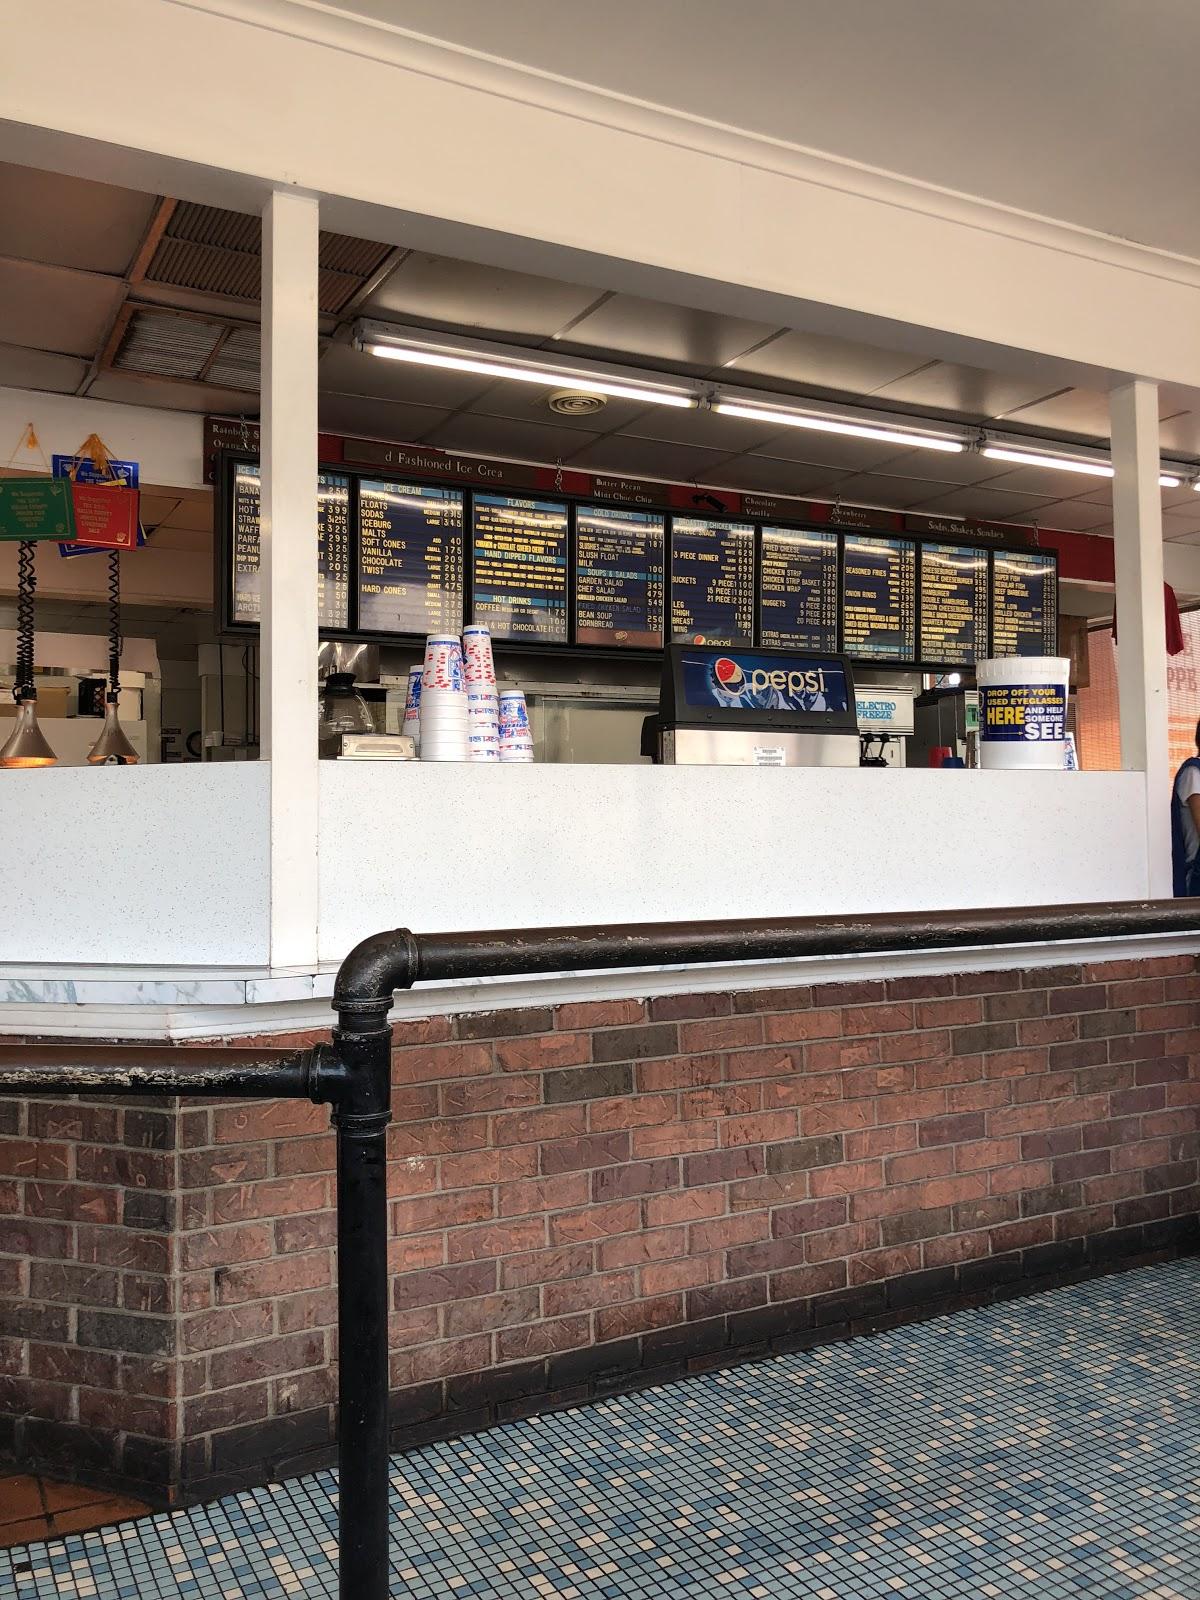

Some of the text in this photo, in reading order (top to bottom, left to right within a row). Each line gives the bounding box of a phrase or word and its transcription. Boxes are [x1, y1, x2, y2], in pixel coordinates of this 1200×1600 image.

[398, 453, 450, 471] Fashioned
[457, 461, 472, 474] Ice
[384, 483, 394, 492] ICE
[397, 485, 422, 495] CREAM
[596, 478, 641, 491] Butter Pecan
[593, 490, 611, 499] Mint
[635, 495, 652, 504] Chip
[360, 499, 388, 510] FLOATS
[507, 499, 536, 509] FLAVORS
[745, 497, 777, 508] Chocolate
[238, 505, 347, 515] HOT 399
[360, 509, 384, 519] SODAS
[746, 508, 770, 518] Vanilla
[327, 524, 347, 533] 325
[361, 519, 392, 530] ICEBURG
[709, 522, 733, 530] CHICKEN
[361, 528, 386, 538] MALTS
[328, 534, 347, 543] 299
[328, 543, 347, 553] 325
[361, 538, 381, 547] SOFT
[383, 540, 406, 550] CONES
[649, 540, 663, 548] 187
[762, 543, 800, 554] FRIED CHEESE
[361, 547, 392, 557] VANILLA
[444, 546, 462, 555] 175
[578, 551, 620, 561] SLUSH FLOAT
[679, 551, 697, 560] PIECE
[698, 553, 719, 562] DINNER
[328, 553, 347, 562] 325
[361, 556, 403, 568] CHOCOLATE
[484, 550, 557, 564] HAND DIPPED FLAVORS
[329, 563, 348, 572] 205
[361, 565, 462, 575] TWIST 260
[578, 559, 663, 574] MILK 100
[335, 572, 348, 581] 25
[587, 569, 607, 577] SOUPS
[615, 571, 638, 579] SALADS
[762, 568, 785, 576] CHICKEN
[872, 569, 887, 577] FRIES
[444, 574, 462, 582] 285
[762, 576, 785, 584] CHICKEN
[785, 577, 800, 585] STRIP
[578, 577, 663, 590] GARDEN SALAD 349
[717, 579, 734, 588] PIECE
[762, 584, 801, 593] CHICKEN WRAP
[361, 583, 462, 596] HARD CONES 475
[595, 586, 615, 594] SALAD
[715, 587, 731, 595] PIECE
[493, 595, 532, 605] HOT DRINKS
[672, 601, 685, 609] LEG
[715, 596, 731, 604] PIECE
[762, 599, 786, 608] NUGGETS
[805, 602, 820, 610] PIECE
[475, 602, 500, 612] COFFEE
[672, 609, 690, 617] THIGH
[805, 610, 820, 618] PIECE
[578, 619, 614, 628] CORNBREAD
[647, 615, 663, 623] 250
[672, 617, 694, 625] BREAST
[805, 618, 820, 626] PIECE
[498, 622, 548, 633] HOT CHOCOLATE
[673, 625, 688, 633] WING
[762, 630, 779, 638] EXTRAS
[752, 667, 825, 697] pepsi
[987, 689, 1008, 697] DROP
[1032, 688, 1056, 696] YOUR
[857, 701, 897, 711] ELECTRO
[987, 697, 1064, 706] USED EYEGLASSES
[857, 711, 893, 720] FREEZE
[987, 706, 1025, 725] HERE
[1046, 706, 1064, 714] HELP
[1024, 722, 1063, 740] SEE
